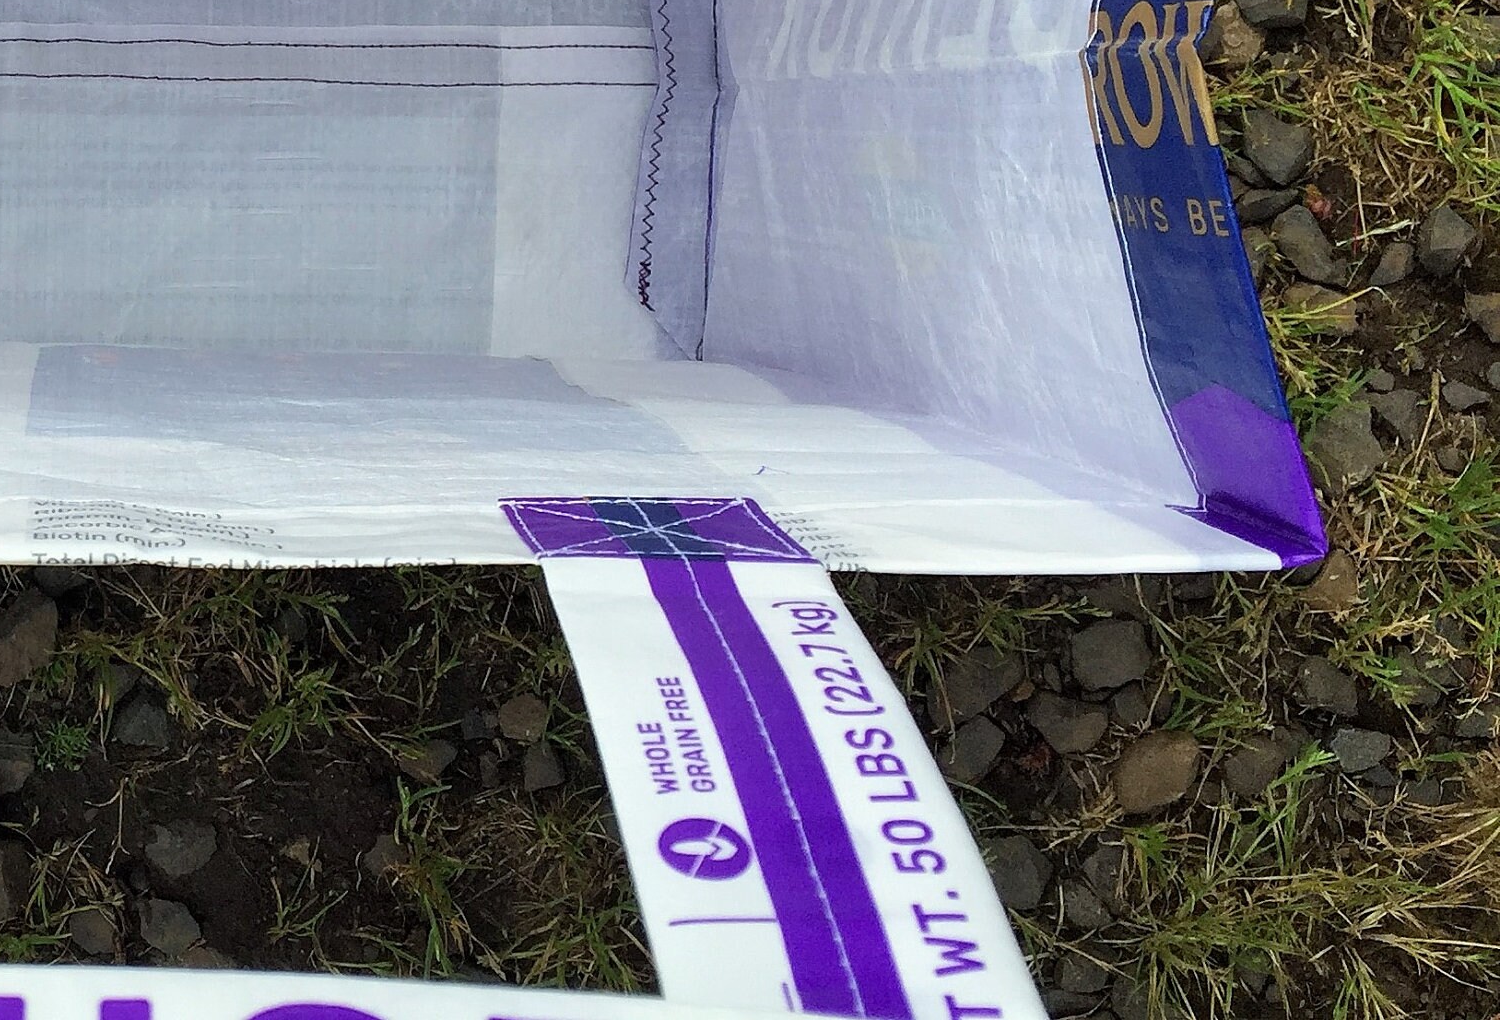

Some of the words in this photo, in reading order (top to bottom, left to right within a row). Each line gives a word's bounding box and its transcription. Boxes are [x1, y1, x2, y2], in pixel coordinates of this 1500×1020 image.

[1187, 198, 1230, 238] BE
[33, 532, 106, 541] Biotin
[771, 600, 839, 637] kg)
[656, 676, 690, 722] FREE
[799, 643, 885, 717] (22.7
[637, 722, 680, 795] WHOLE
[673, 725, 716, 794] GRAIN
[844, 727, 918, 804] LBS
[881, 818, 947, 875] 50
[911, 890, 985, 977] WT.
